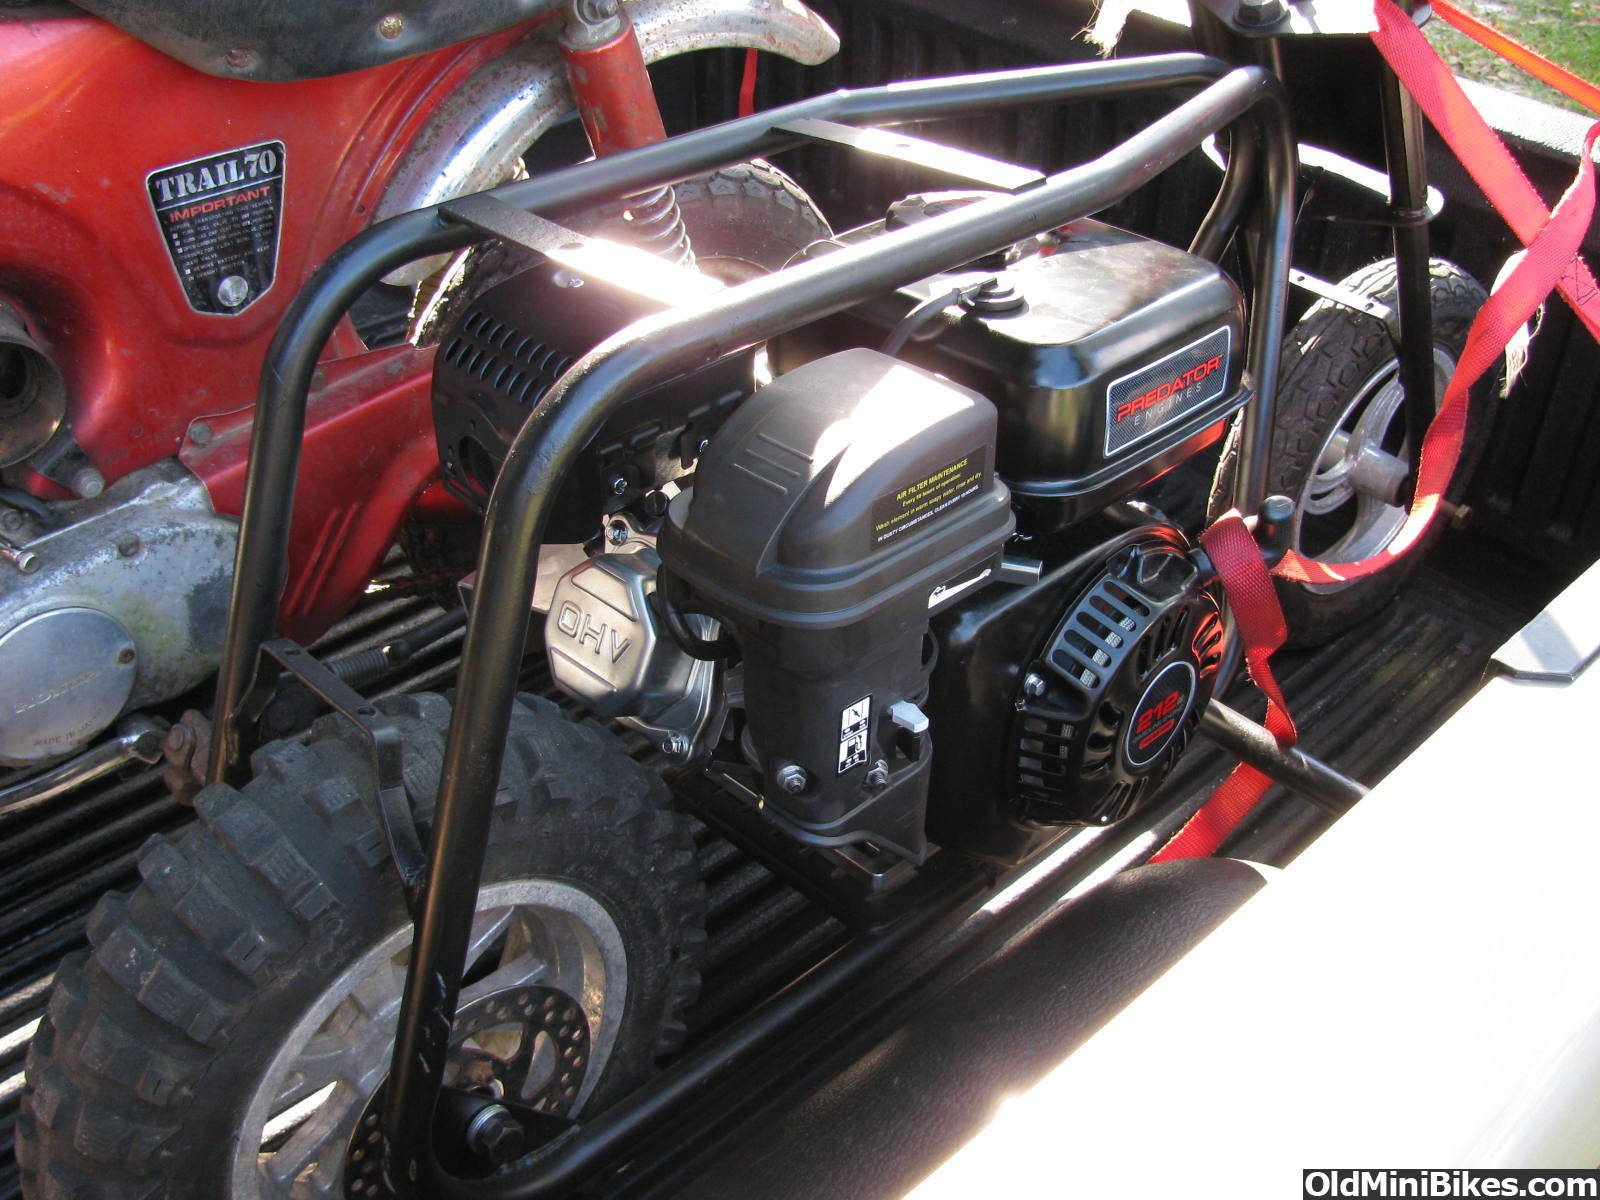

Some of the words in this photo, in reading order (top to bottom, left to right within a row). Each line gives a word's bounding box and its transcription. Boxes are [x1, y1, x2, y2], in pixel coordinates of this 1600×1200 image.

[156, 160, 245, 202] TRAIL
[244, 150, 276, 178] 70
[169, 186, 270, 223] IMPORTANT
[1116, 354, 1222, 422] PREDATOR
[1134, 382, 1202, 426] ENGINES
[896, 490, 907, 501] AIR
[908, 481, 928, 496] FILTER
[928, 458, 968, 485] MAINTENANCE
[557, 599, 634, 664] OHV
[1136, 691, 1180, 734] 212
